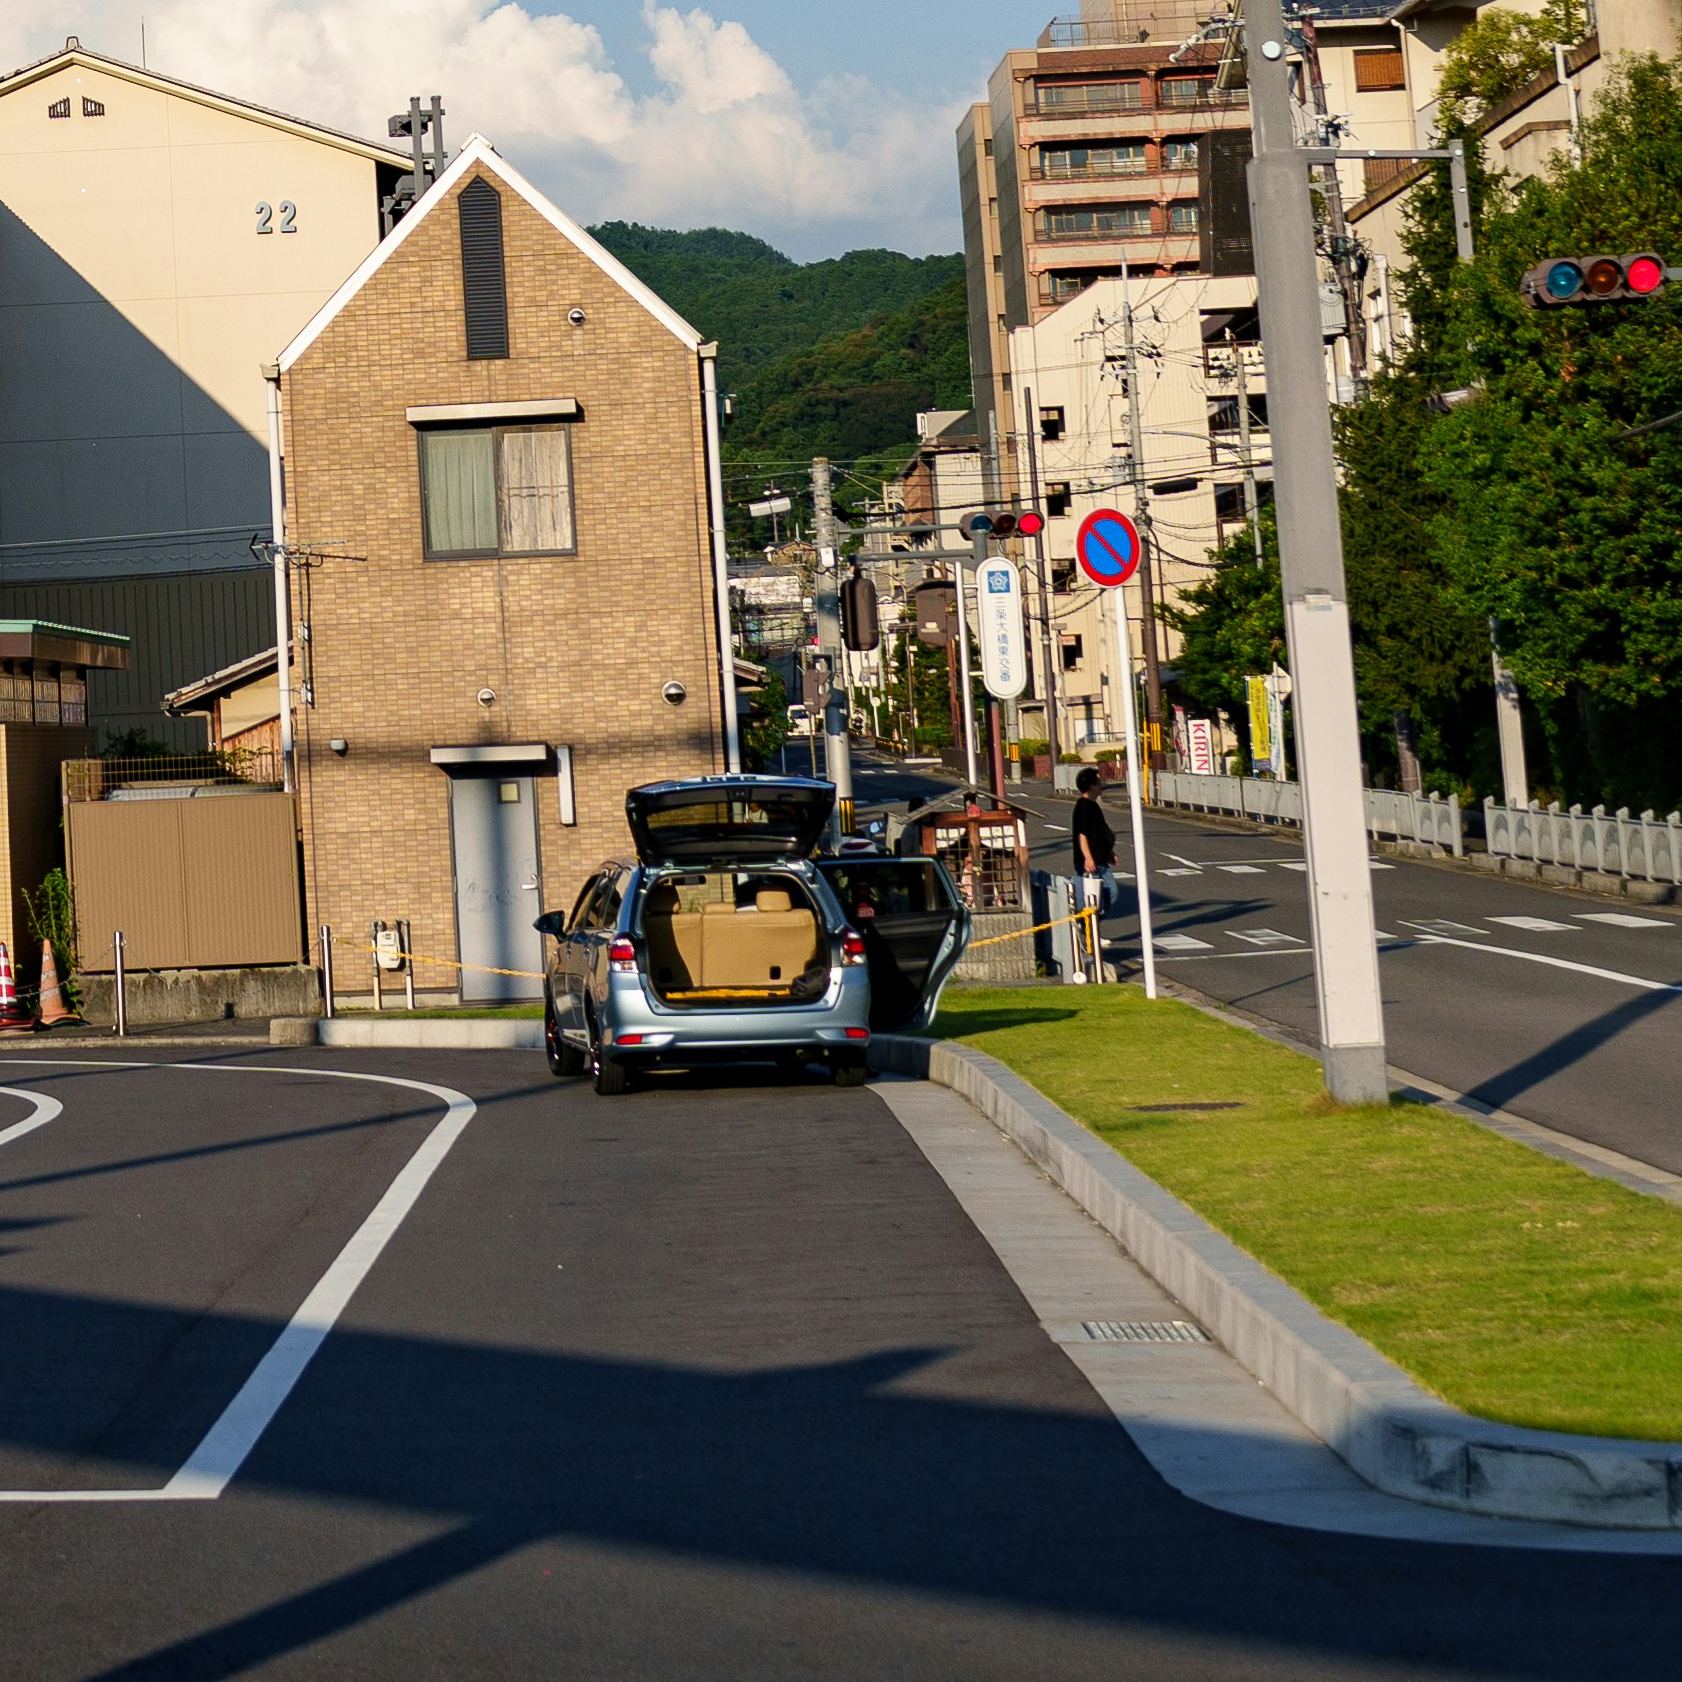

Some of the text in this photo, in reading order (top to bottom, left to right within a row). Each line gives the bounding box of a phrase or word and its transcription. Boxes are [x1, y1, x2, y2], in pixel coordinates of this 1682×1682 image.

[255, 200, 297, 235] 22
[994, 596, 1011, 682] 三条大橋東交番
[1193, 723, 1209, 771] KIRIN
